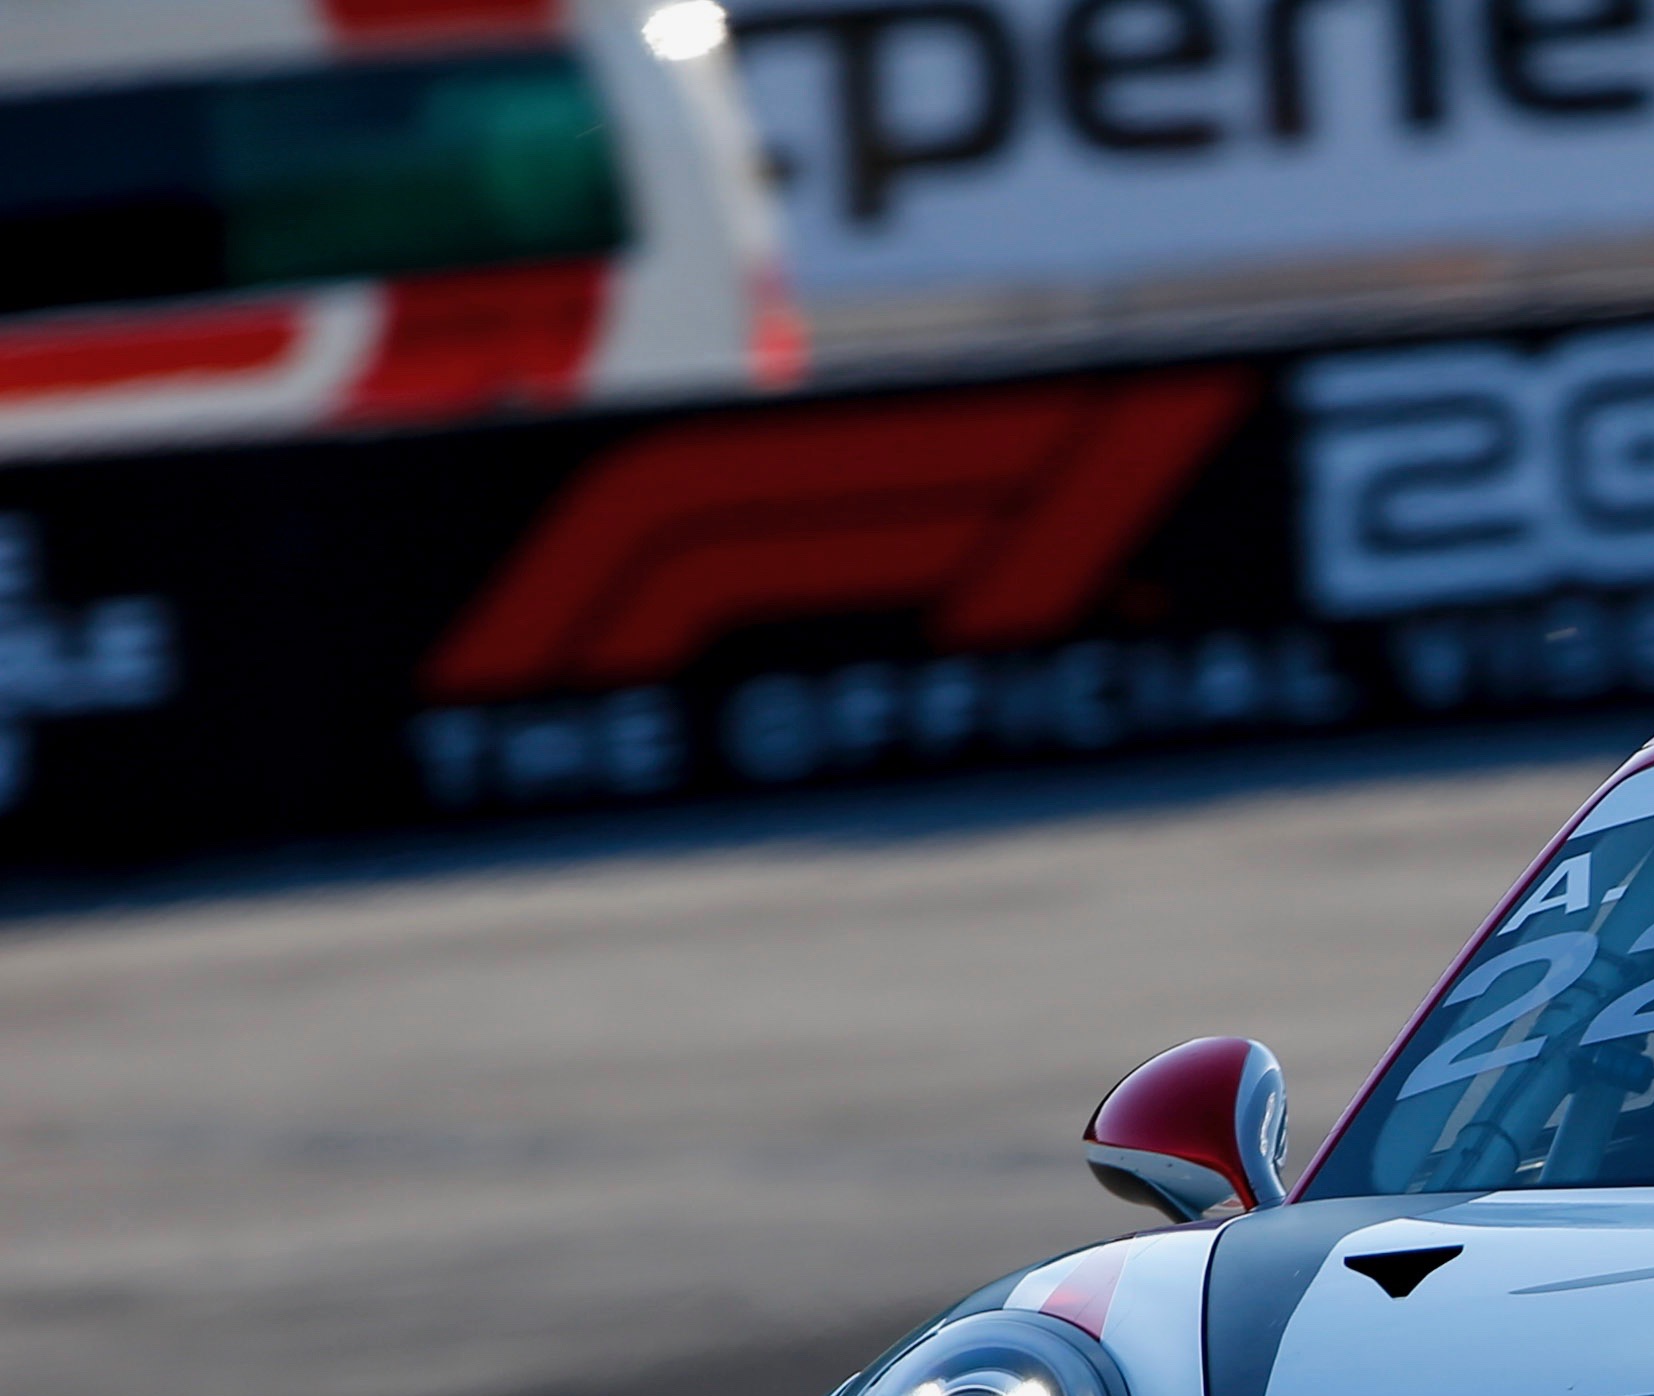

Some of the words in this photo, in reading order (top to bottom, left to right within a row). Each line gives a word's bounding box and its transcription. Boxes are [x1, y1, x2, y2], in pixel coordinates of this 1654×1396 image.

[405, 690, 685, 805] THE
[720, 635, 1355, 785] OFFICIAL
[1499, 852, 1631, 935] A.
